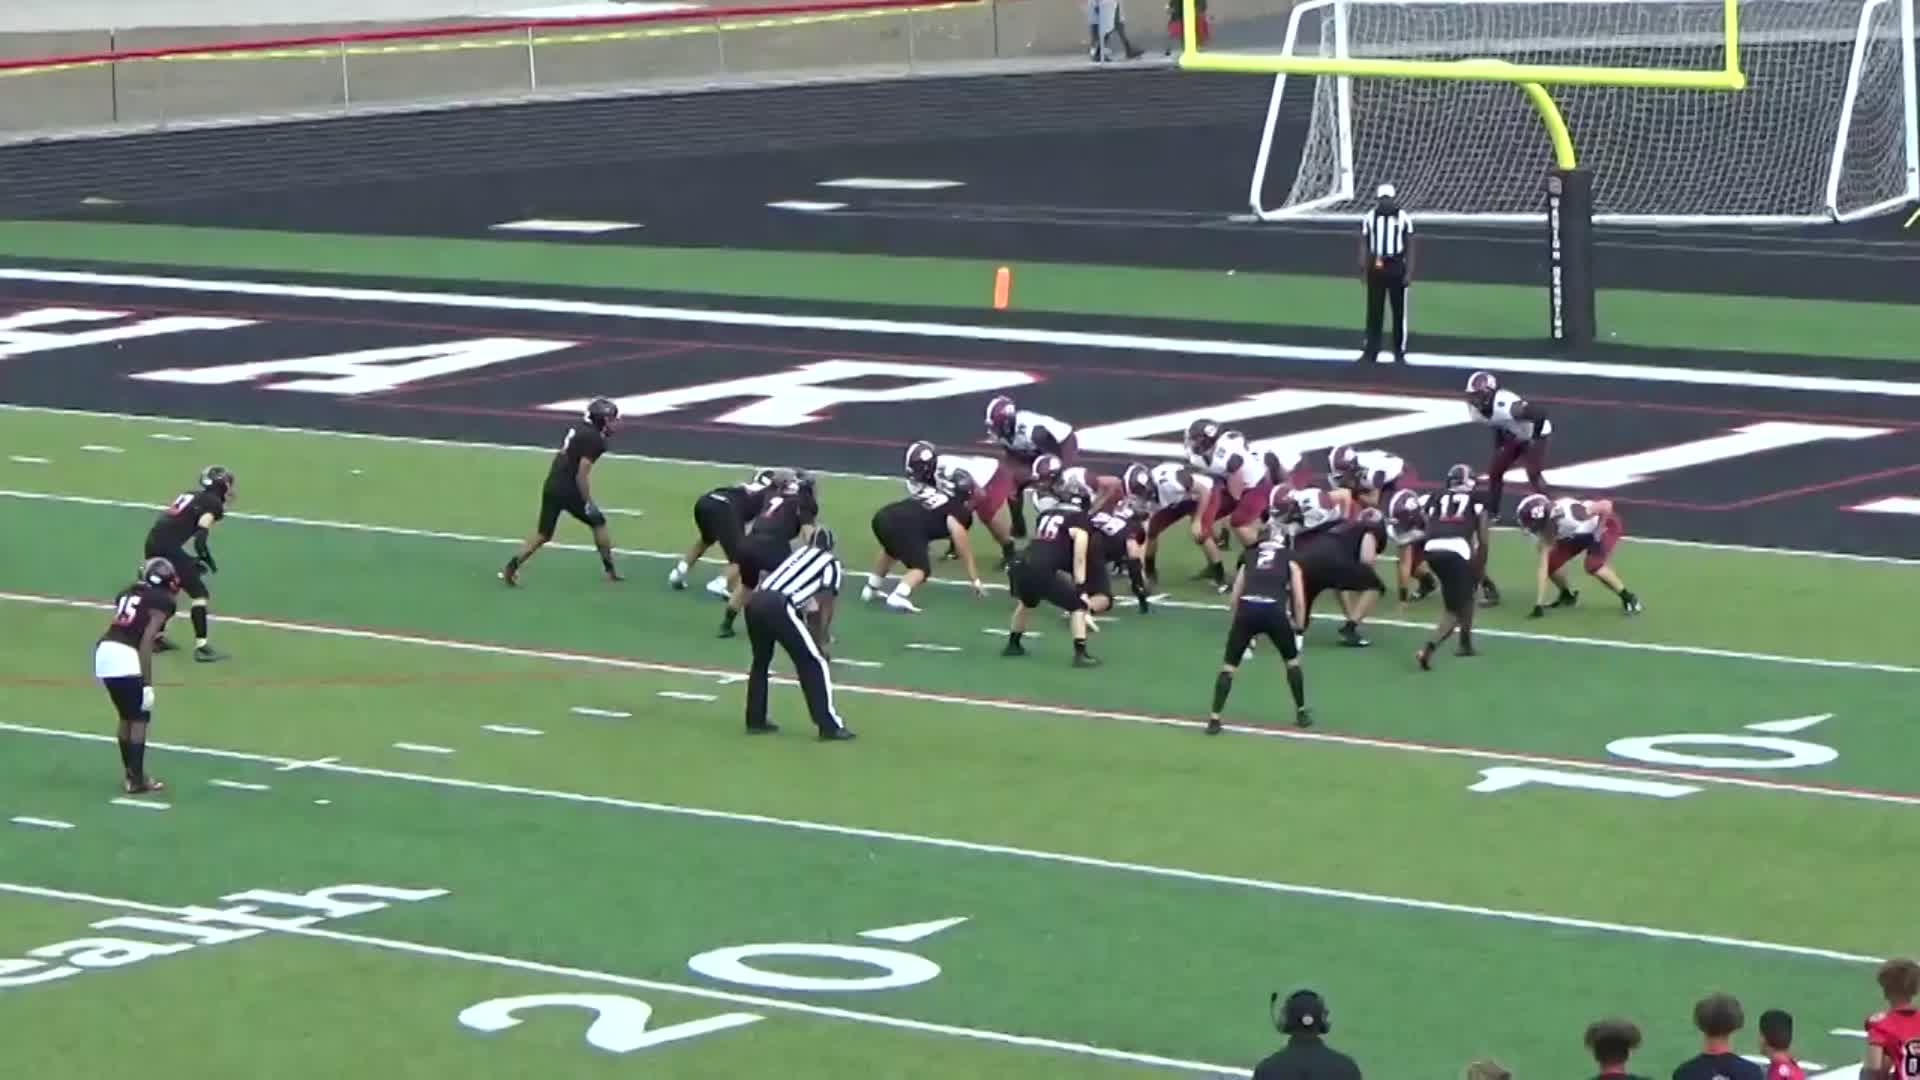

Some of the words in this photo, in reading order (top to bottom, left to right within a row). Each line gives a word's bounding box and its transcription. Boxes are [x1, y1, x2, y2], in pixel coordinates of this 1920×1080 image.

[1440, 493, 1470, 520] 17
[1037, 514, 1065, 540] 16
[112, 594, 142, 624] 15
[1466, 733, 1840, 798] 10
[458, 942, 942, 1053] 20
